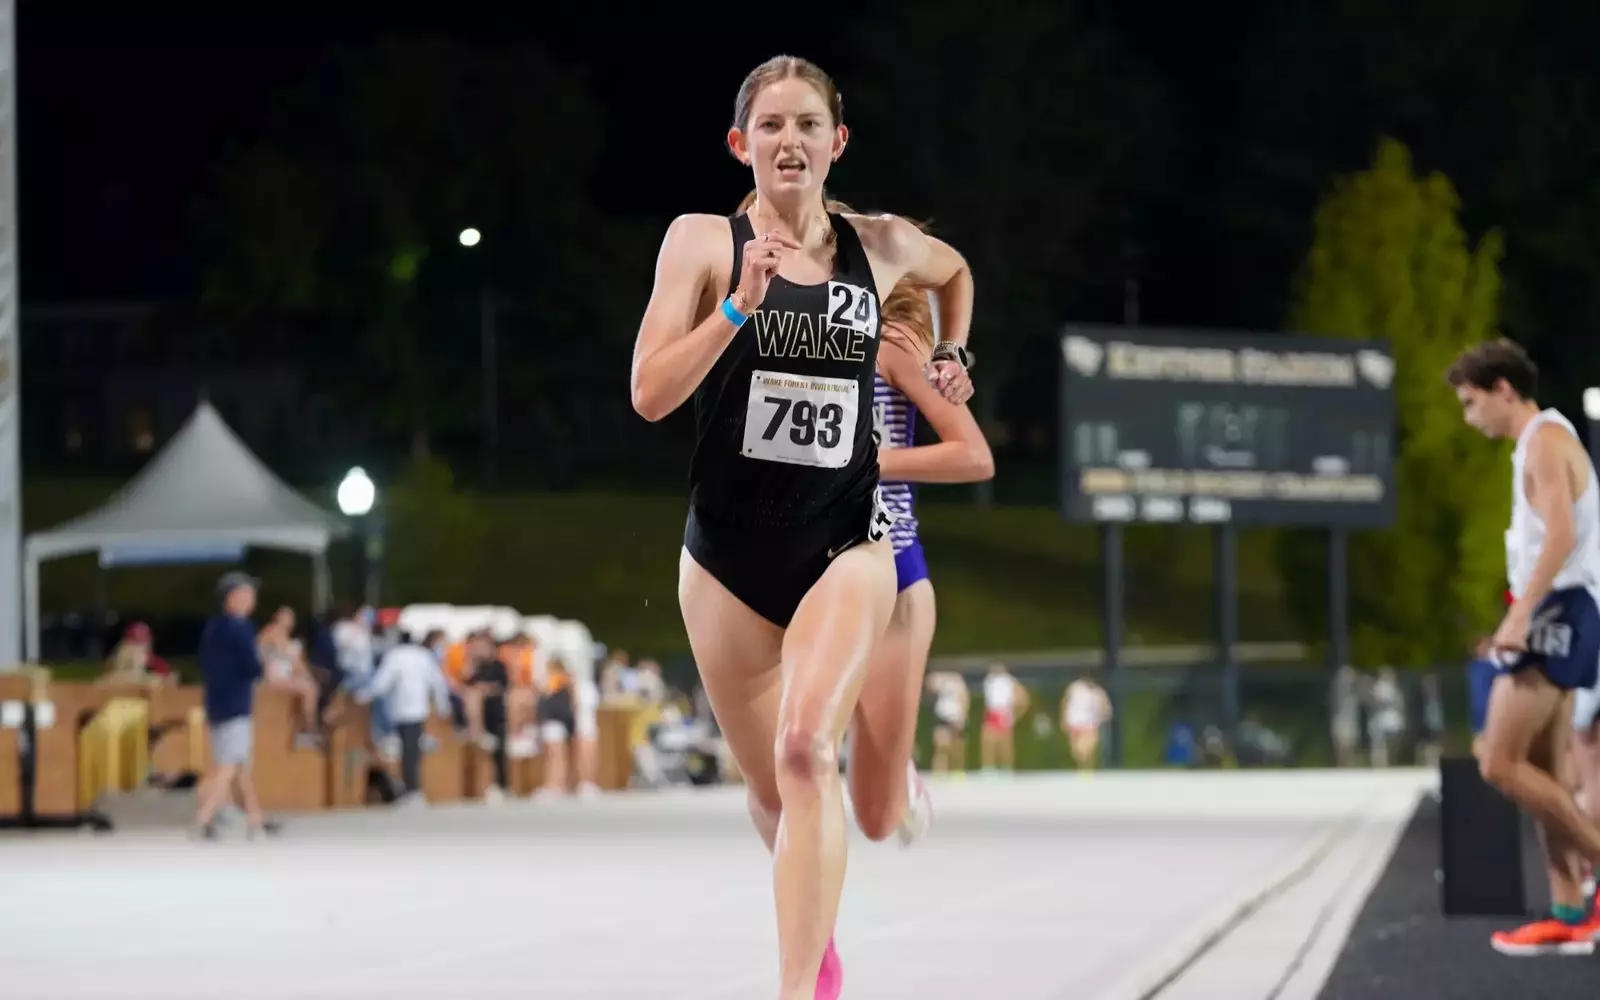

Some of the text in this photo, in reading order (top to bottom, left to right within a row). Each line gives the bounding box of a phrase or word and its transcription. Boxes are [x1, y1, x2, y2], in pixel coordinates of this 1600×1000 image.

[831, 285, 870, 332] 24
[753, 310, 865, 362] WAKE
[763, 376, 782, 386] WAKE
[783, 379, 808, 389] FOREST
[762, 396, 844, 449] 793
